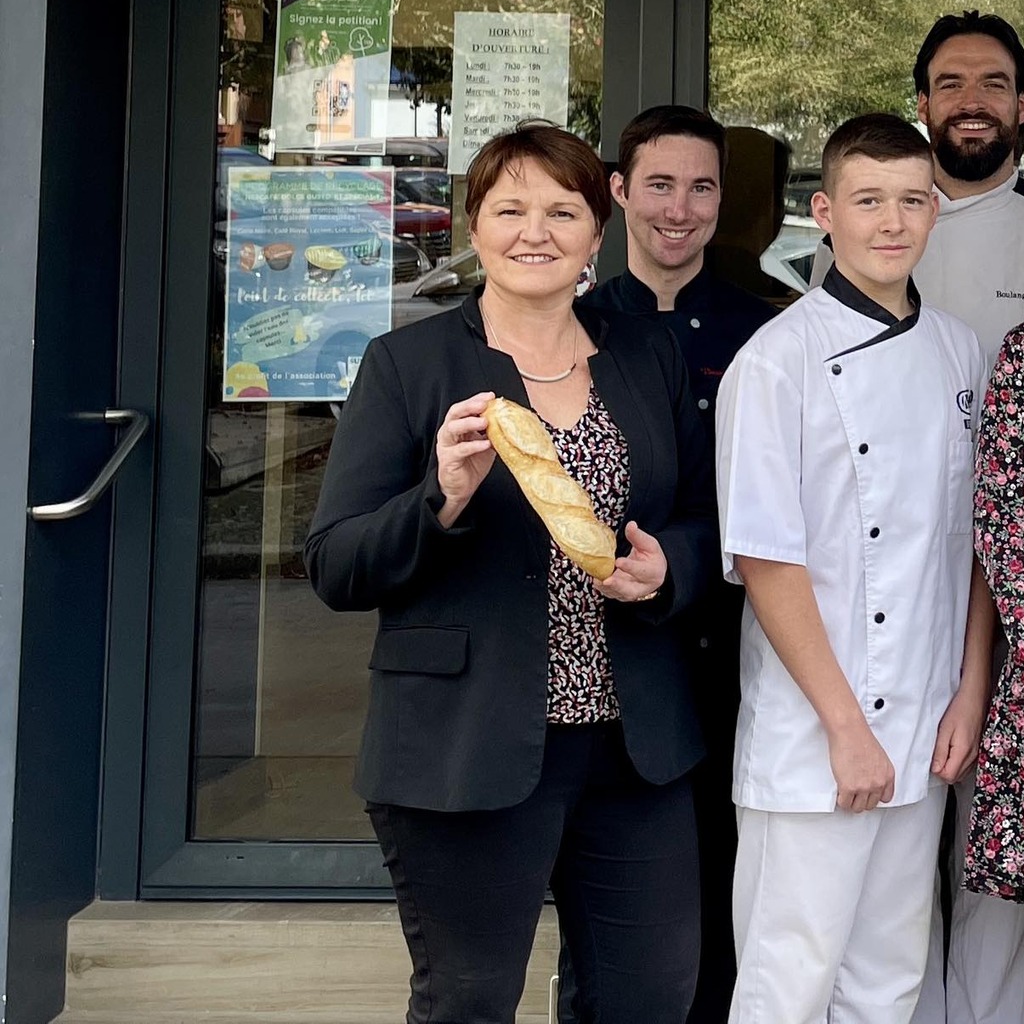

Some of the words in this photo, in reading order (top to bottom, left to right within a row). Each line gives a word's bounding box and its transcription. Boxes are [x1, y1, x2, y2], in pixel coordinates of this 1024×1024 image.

[289, 12, 324, 26] Signez
[326, 14, 336, 25] la
[504, 62, 520, 71] 7h30
[272, 372, 282, 380] de
